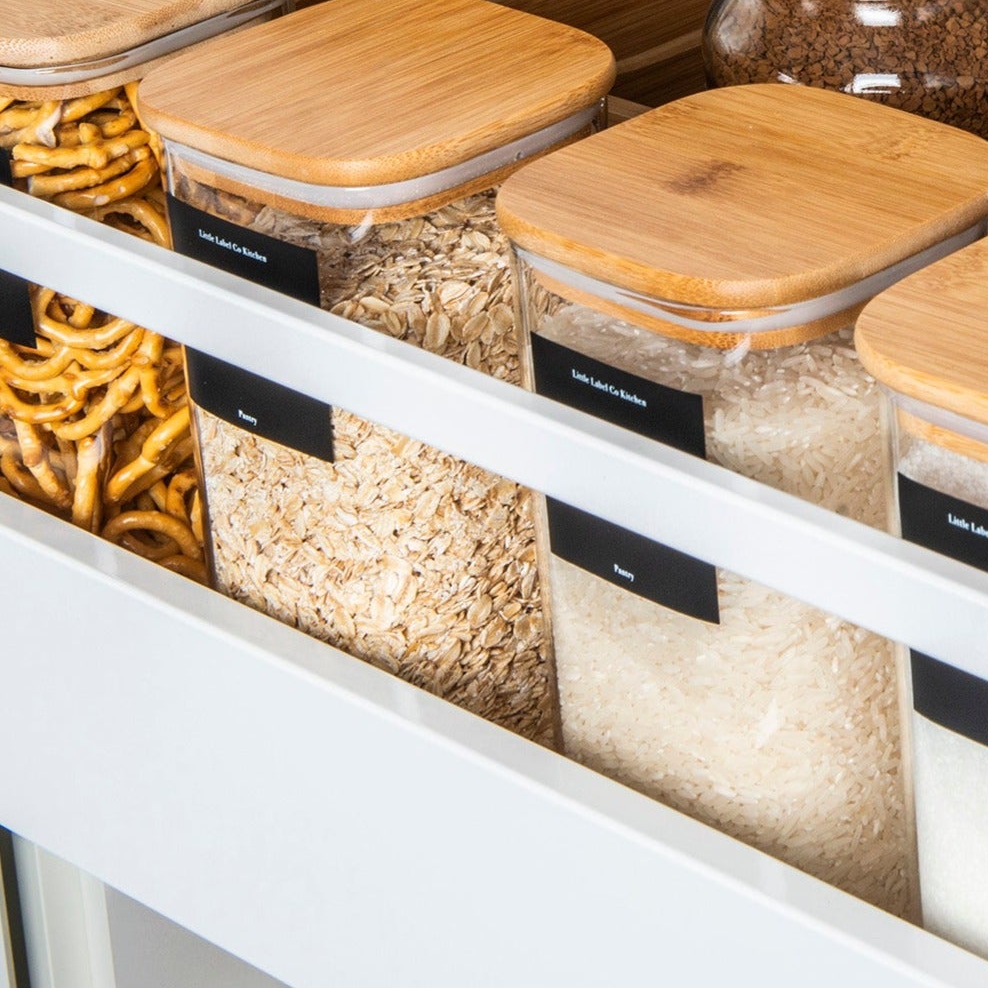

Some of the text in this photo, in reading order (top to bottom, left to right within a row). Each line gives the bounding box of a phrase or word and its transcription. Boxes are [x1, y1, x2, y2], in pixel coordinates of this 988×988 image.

[198, 229, 267, 263] Little Label Co Kitchen
[571, 368, 647, 408] Little Label Co Kitchen
[238, 409, 257, 427] Pantry
[947, 513, 970, 531] Little
[613, 563, 635, 583] Pantry
